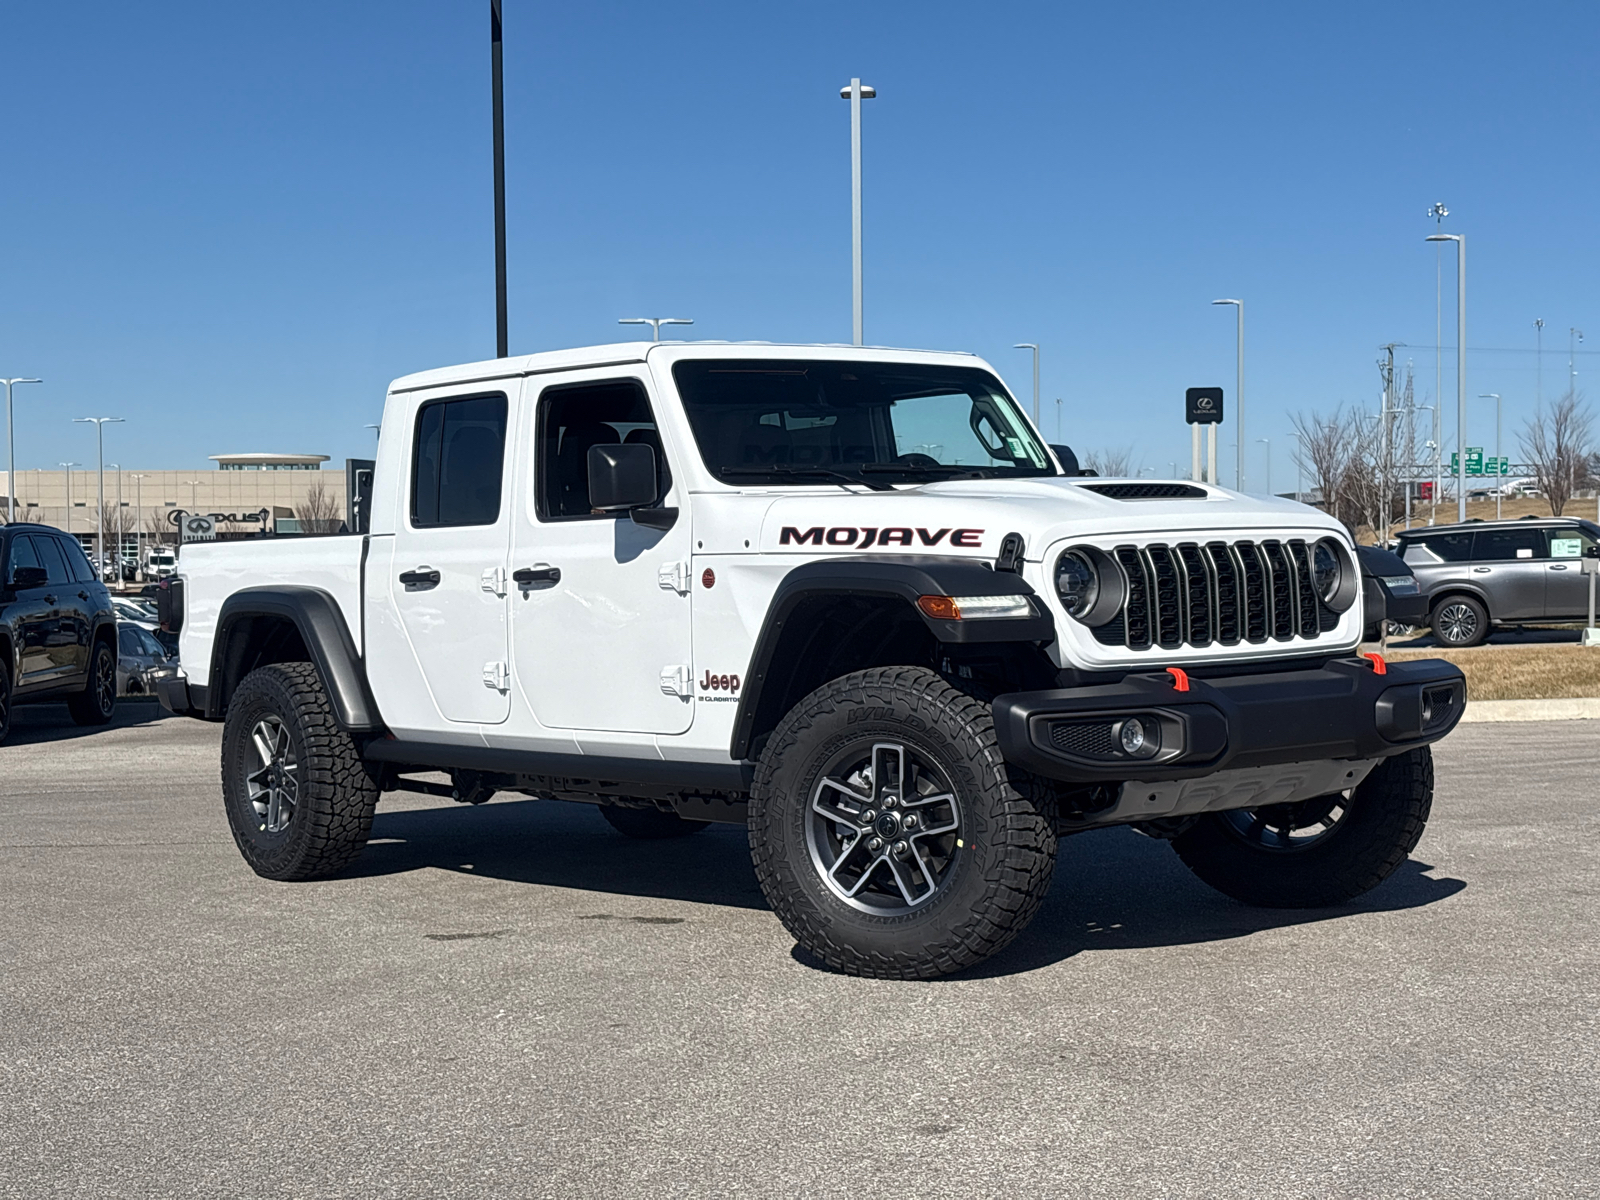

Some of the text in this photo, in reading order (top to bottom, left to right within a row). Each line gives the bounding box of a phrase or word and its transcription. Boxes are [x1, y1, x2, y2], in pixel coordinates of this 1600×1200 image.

[778, 526, 986, 549] MOJAVE
[699, 669, 741, 694] Jeep
[847, 706, 984, 811] WILDPEAK
